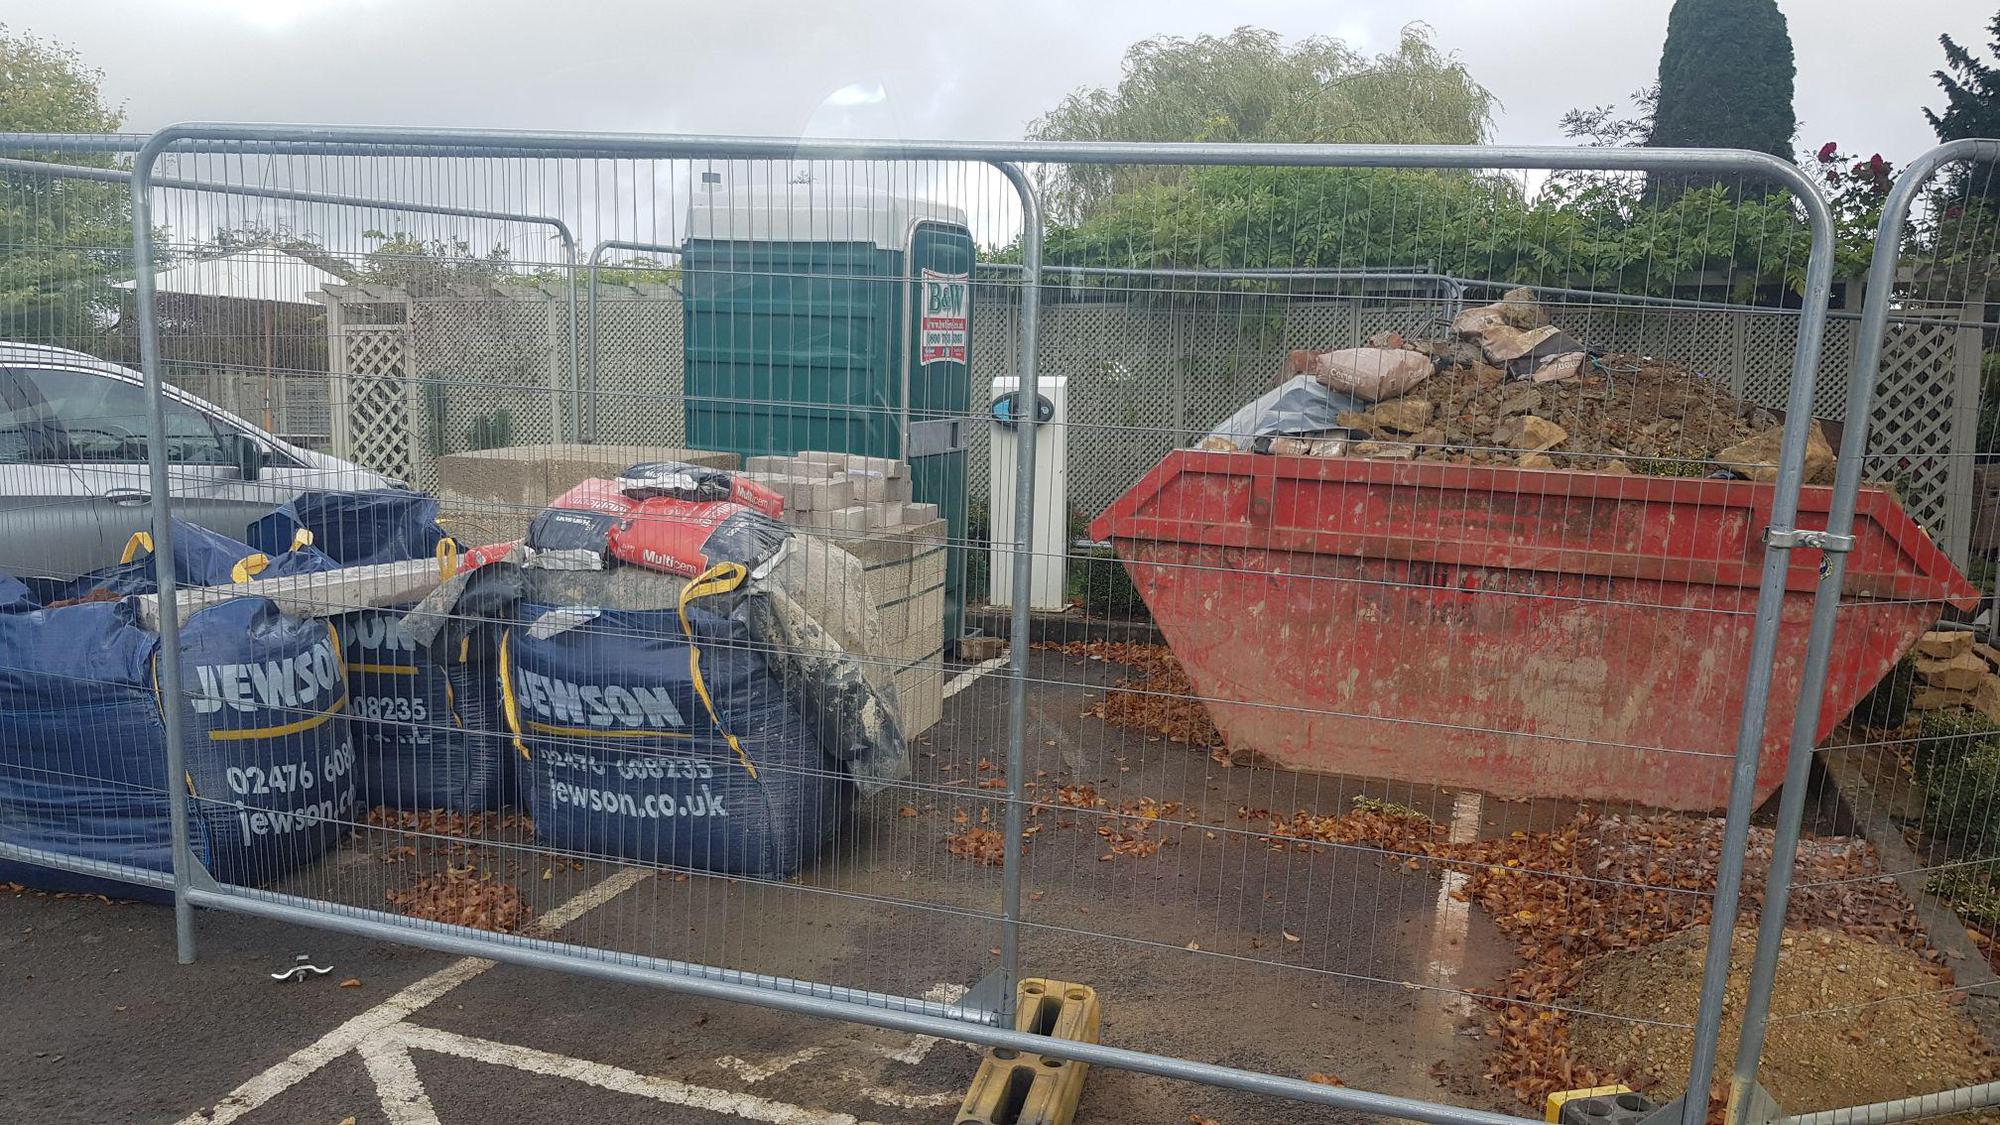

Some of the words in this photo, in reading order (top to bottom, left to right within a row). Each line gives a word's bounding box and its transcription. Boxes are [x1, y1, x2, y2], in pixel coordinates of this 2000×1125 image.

[928, 283, 964, 316] B&W
[643, 549, 697, 573] Multicem
[352, 696, 427, 720] 08235
[518, 667, 685, 727] JEWSON
[226, 761, 314, 795] 02476
[549, 777, 729, 819] jewson.co.uk
